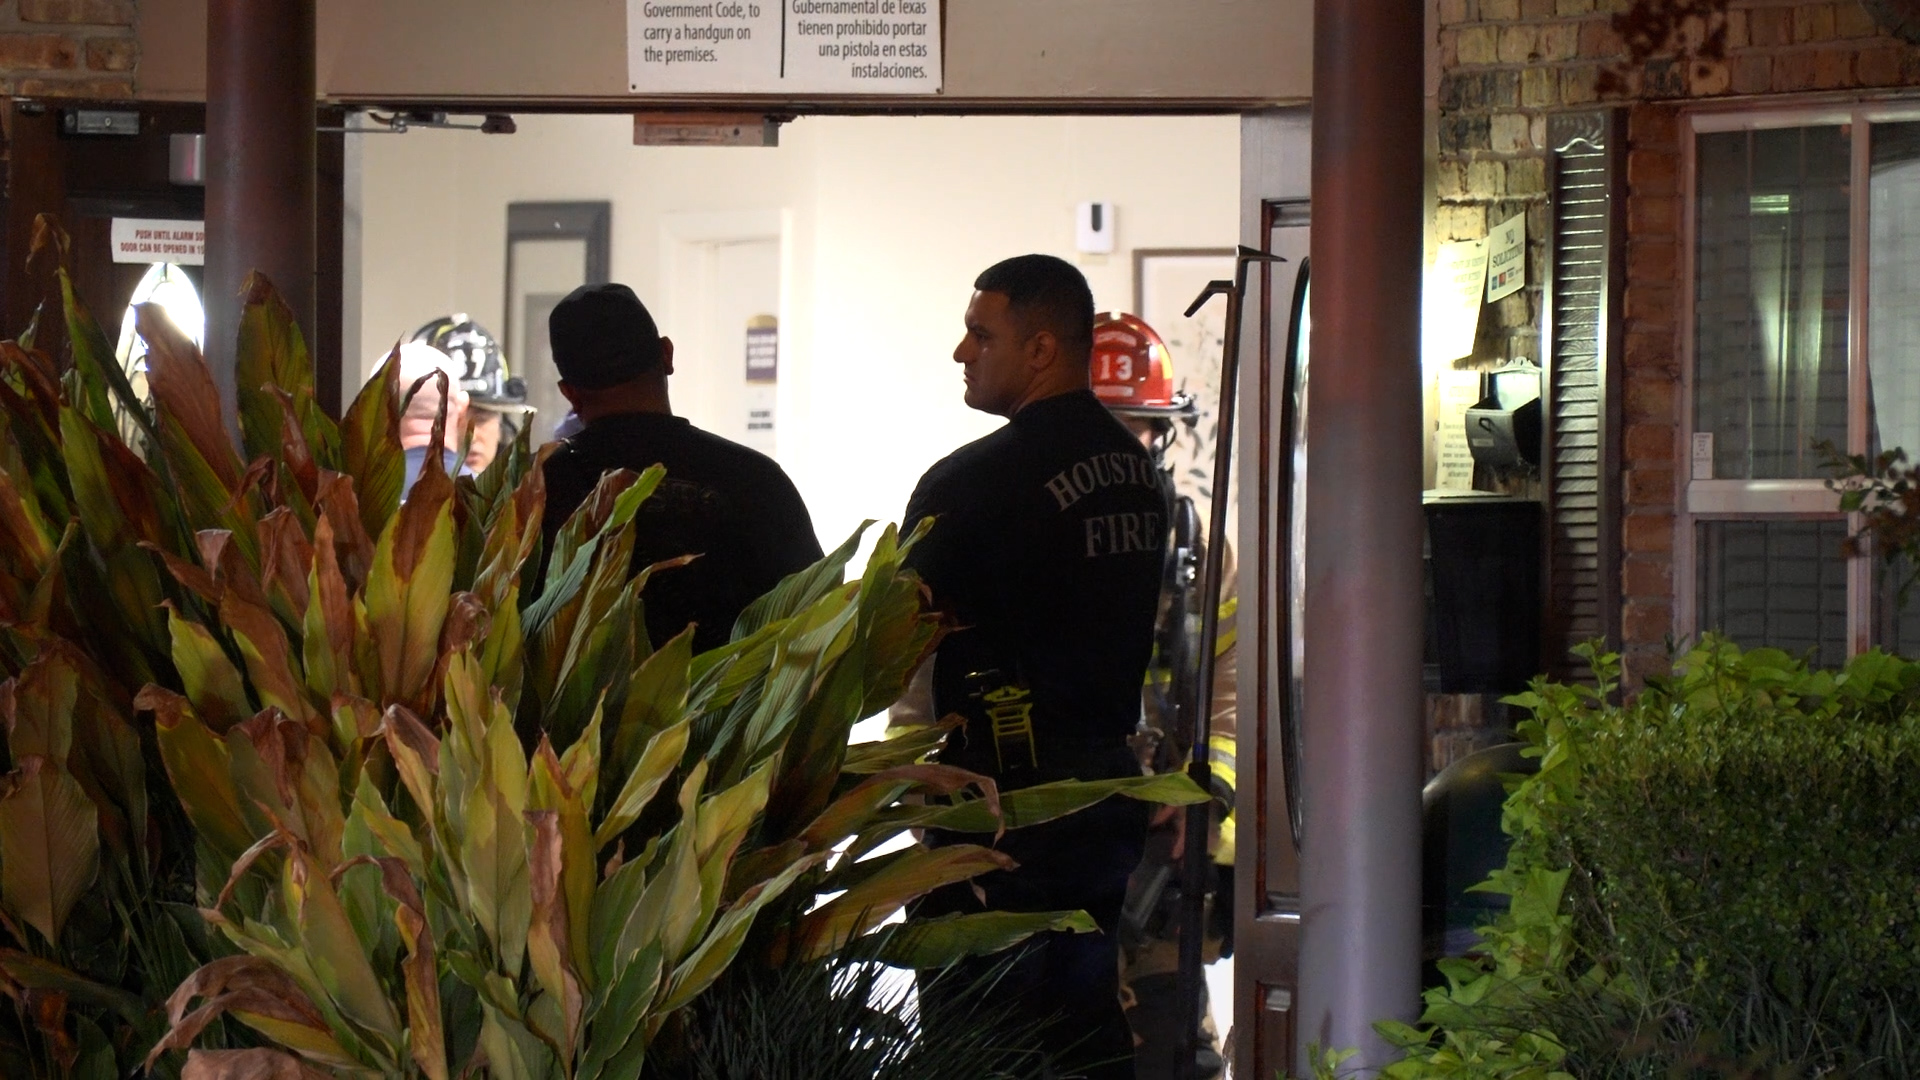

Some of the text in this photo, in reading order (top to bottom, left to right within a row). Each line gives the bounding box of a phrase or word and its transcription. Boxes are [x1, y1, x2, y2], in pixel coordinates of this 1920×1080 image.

[644, 1, 760, 19] Government Code, to
[792, 0, 927, 14] Gubernamental de Texas
[644, 24, 751, 44] carry a handgun on
[798, 20, 927, 39] tienen prohibido portar
[644, 46, 718, 65] the premises.
[819, 41, 927, 60] una pistola en estas
[851, 62, 928, 79] instalaciones.
[136, 230, 152, 240] PUSH
[153, 230, 171, 240] UNTIL
[173, 231, 194, 241] ALARM
[120, 243, 137, 252] DOOR
[139, 243, 152, 253] CAN
[153, 244, 162, 253] BE
[164, 244, 188, 254] OPENED
[189, 246, 196, 254] IN
[1100, 354, 1133, 380] 13
[1084, 512, 1159, 557] FIRE
